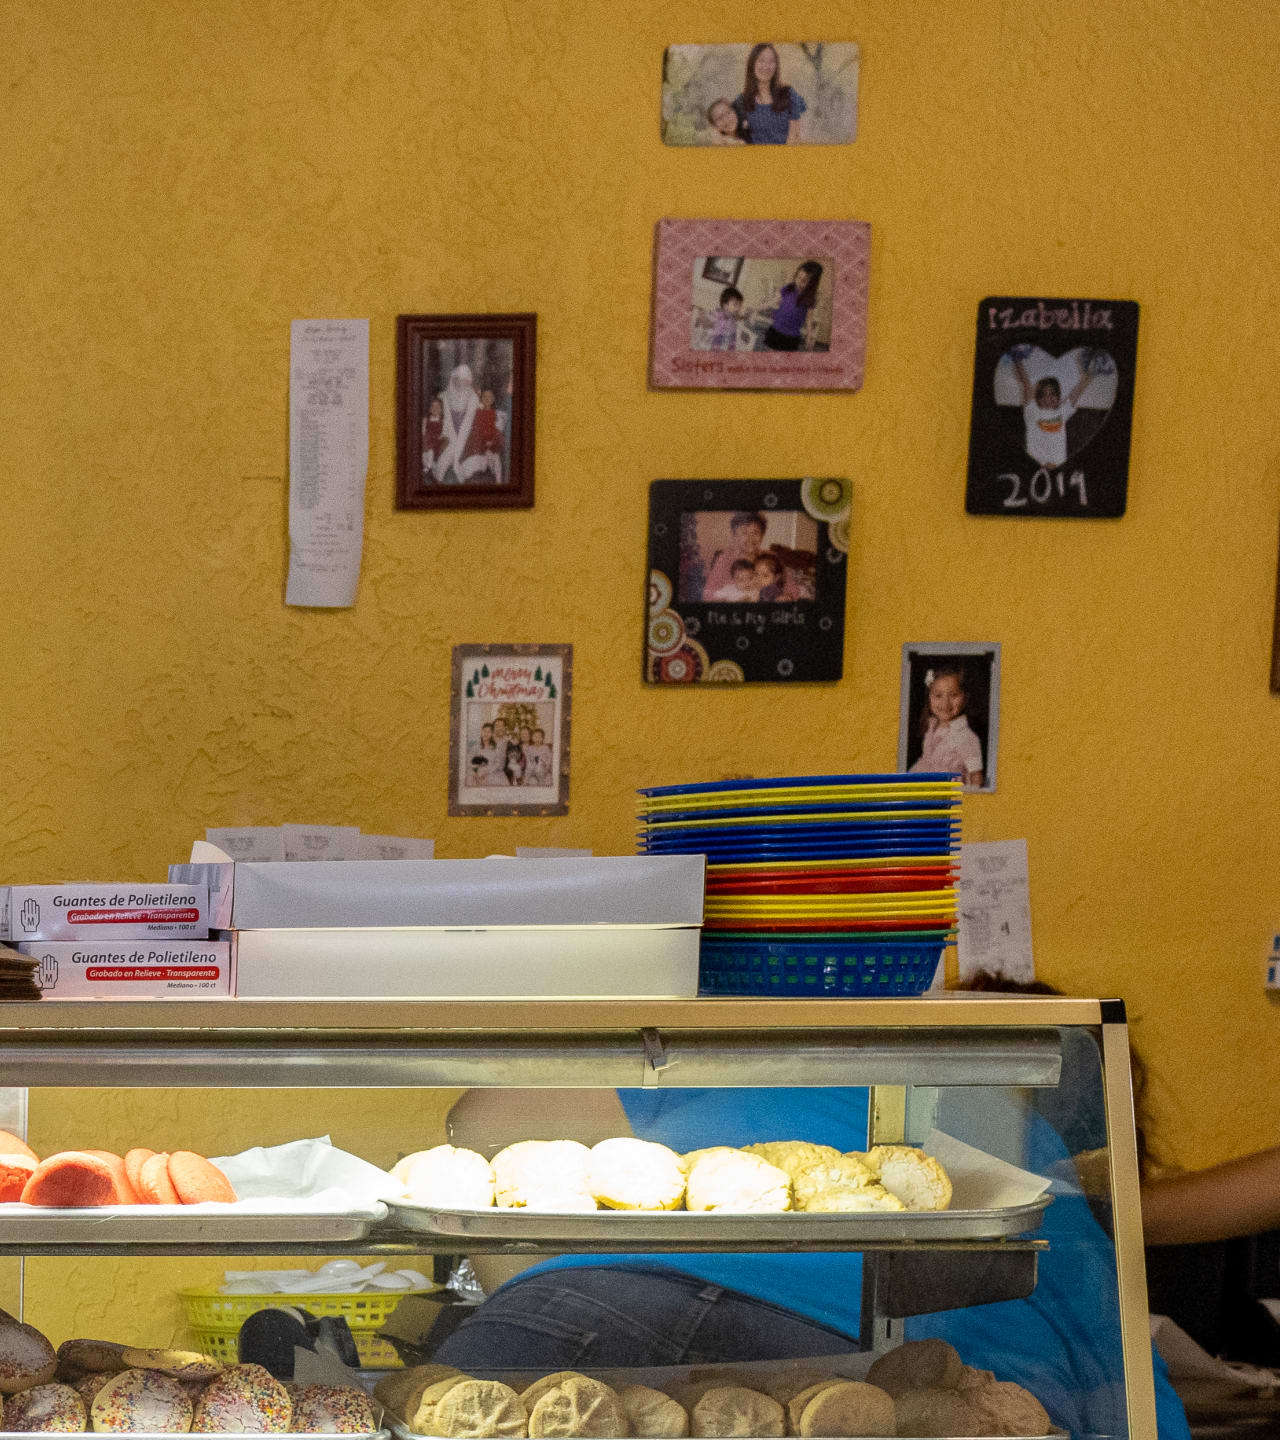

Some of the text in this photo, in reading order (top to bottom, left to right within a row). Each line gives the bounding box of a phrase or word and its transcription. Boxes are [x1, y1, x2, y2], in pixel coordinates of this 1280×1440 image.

[997, 468, 1088, 507] 2019
[53, 894, 196, 907] Guantes de Polietileno
[146, 911, 195, 921] Transparente
[27, 918, 35, 926] M
[72, 951, 216, 964] Guantes de Polietileno
[45, 974, 52, 982] M
[89, 969, 123, 977] Grabado
[134, 969, 161, 977] Relieve
[166, 969, 216, 979] Transparente
